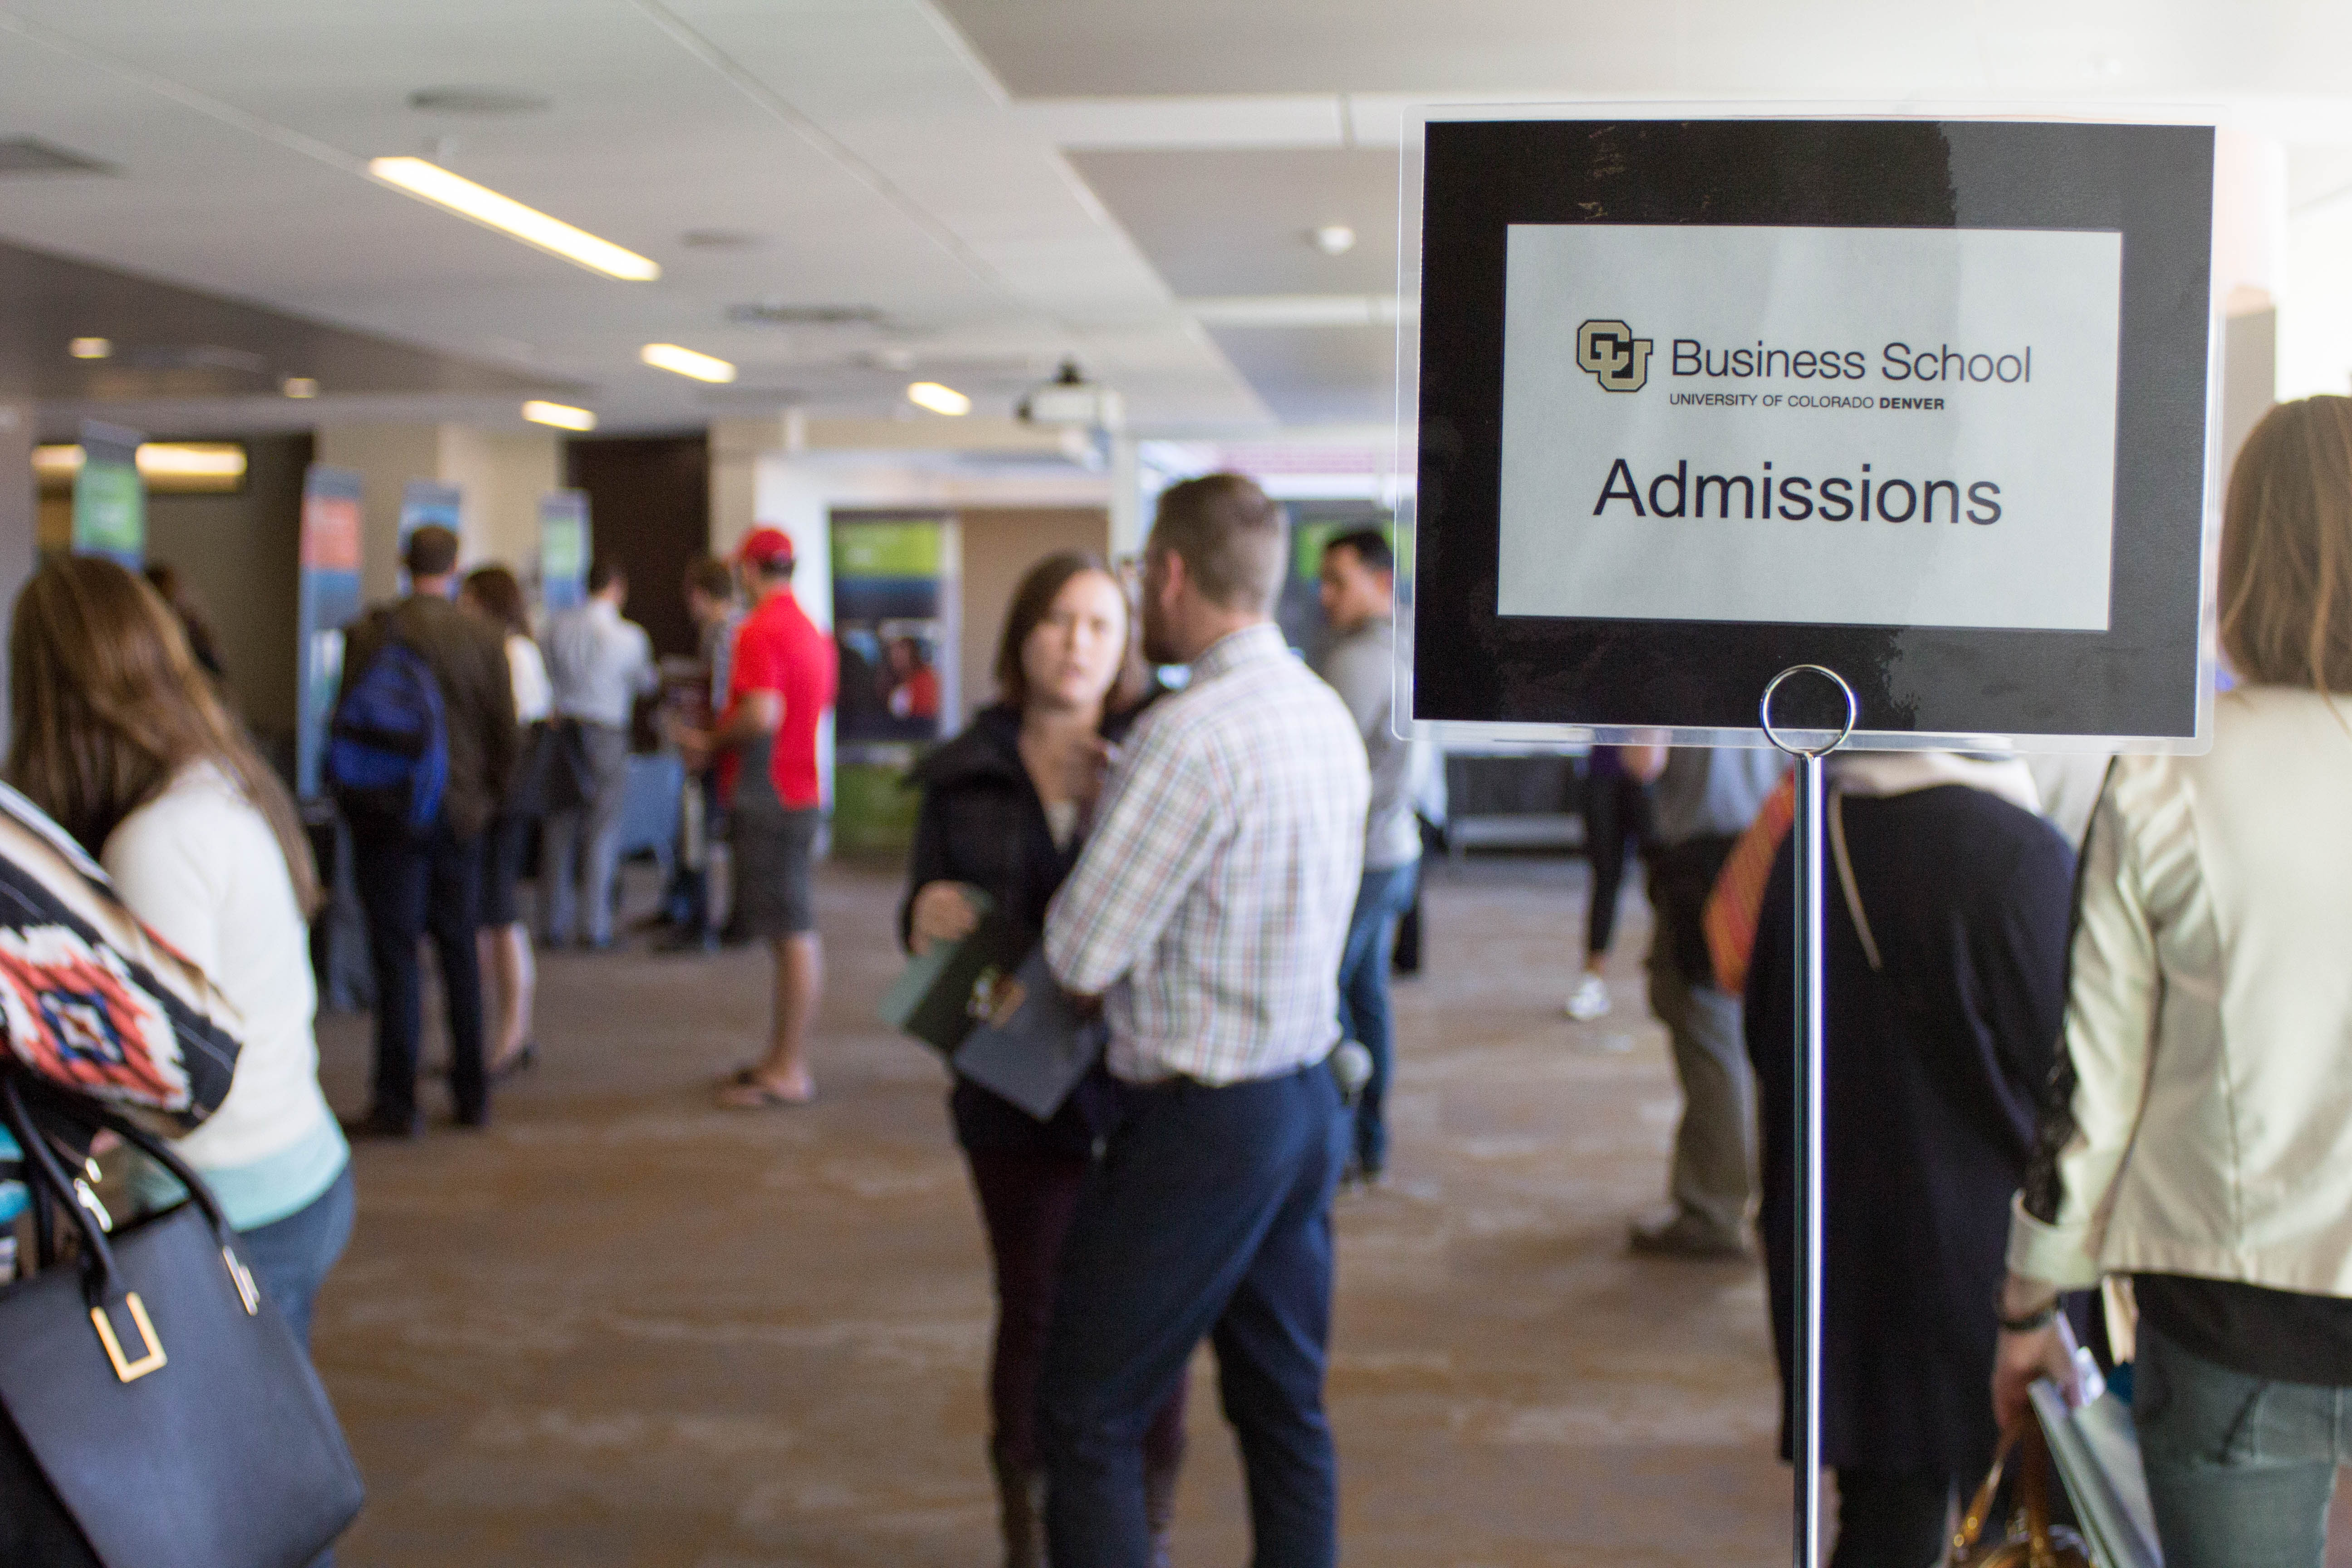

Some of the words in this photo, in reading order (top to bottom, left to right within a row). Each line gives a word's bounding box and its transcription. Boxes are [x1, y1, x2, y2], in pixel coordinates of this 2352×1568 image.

[1671, 338, 1866, 380] Business
[1881, 342, 2031, 383] School
[1670, 393, 1758, 407] UNIVERSITY
[1763, 394, 1784, 407] OF
[1788, 395, 1874, 409] COLORADO
[1879, 397, 1945, 411] DENVER
[1592, 458, 2003, 526] Admissions
